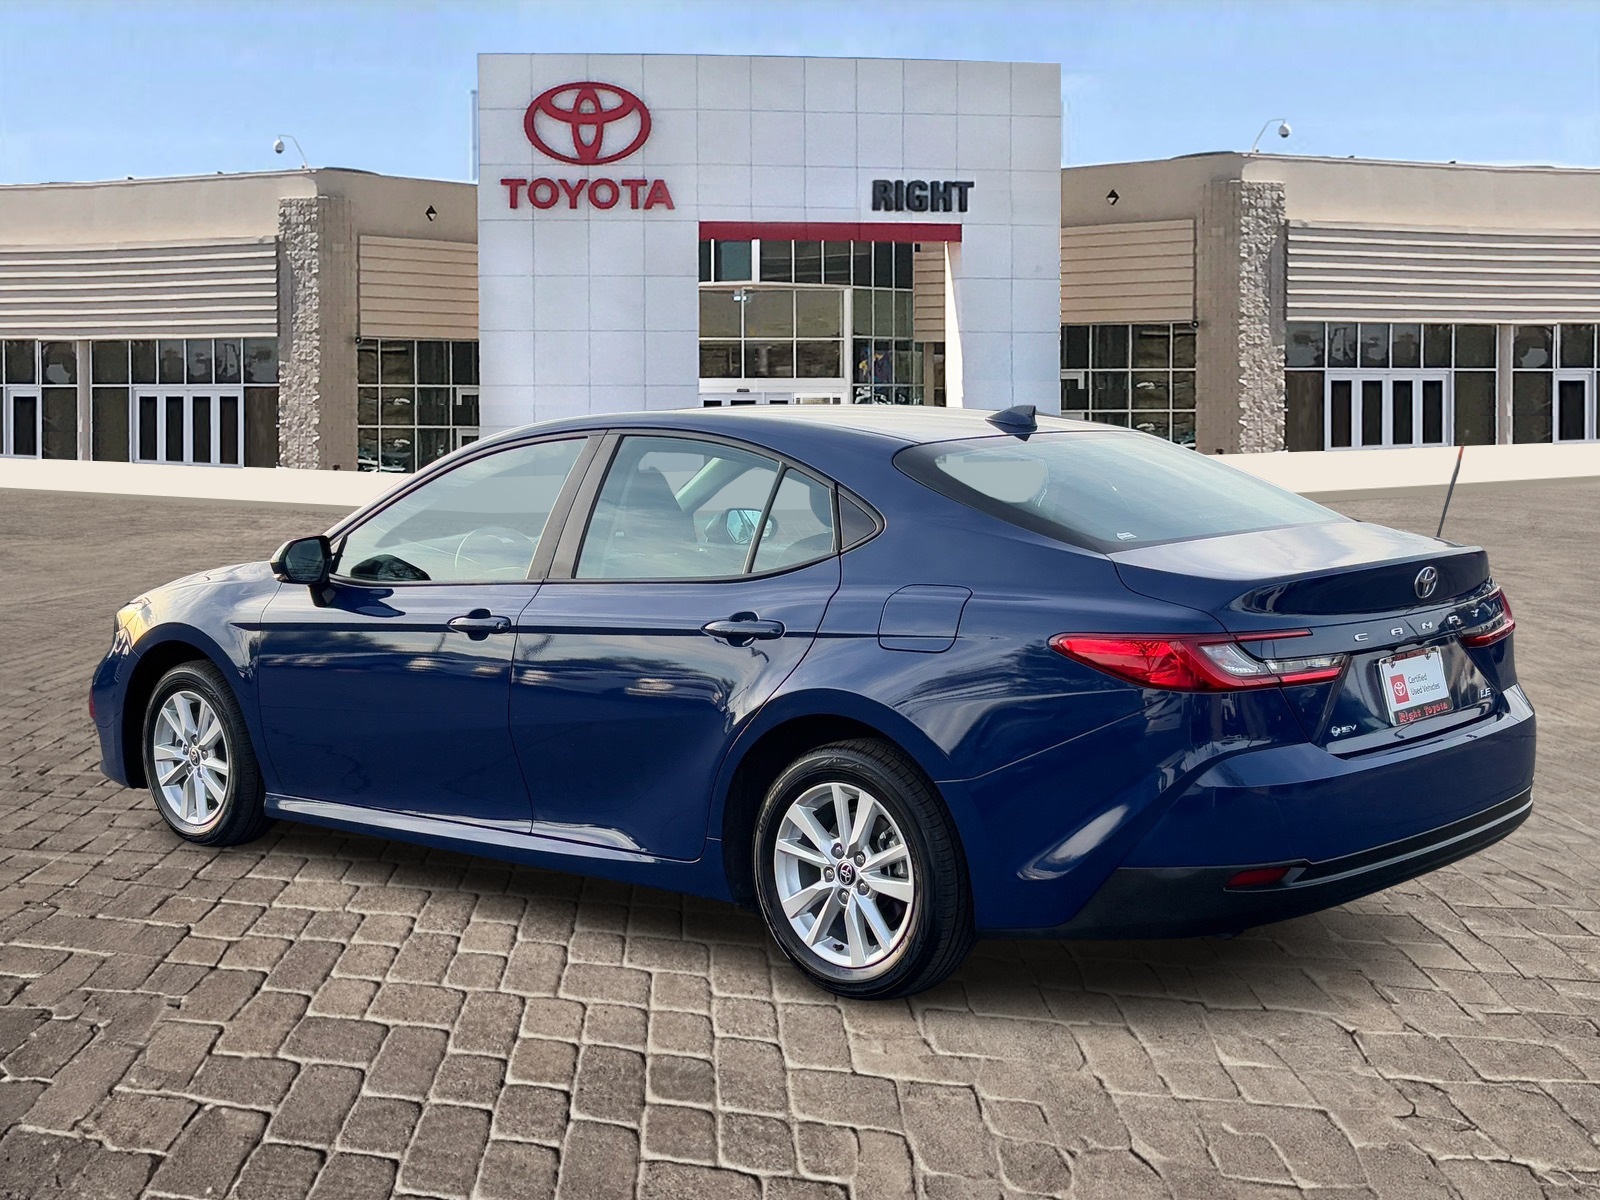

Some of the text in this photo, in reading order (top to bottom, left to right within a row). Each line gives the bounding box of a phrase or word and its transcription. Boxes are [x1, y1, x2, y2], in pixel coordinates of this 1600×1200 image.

[500, 178, 675, 209] TOYOTA
[872, 180, 974, 212] RIGHT
[1354, 608, 1480, 642] CAMRY
[1408, 673, 1427, 684] Certified
[1411, 682, 1441, 695] Used Vehicles
[1480, 687, 1491, 698] LE
[1398, 702, 1448, 723] Right Toyota
